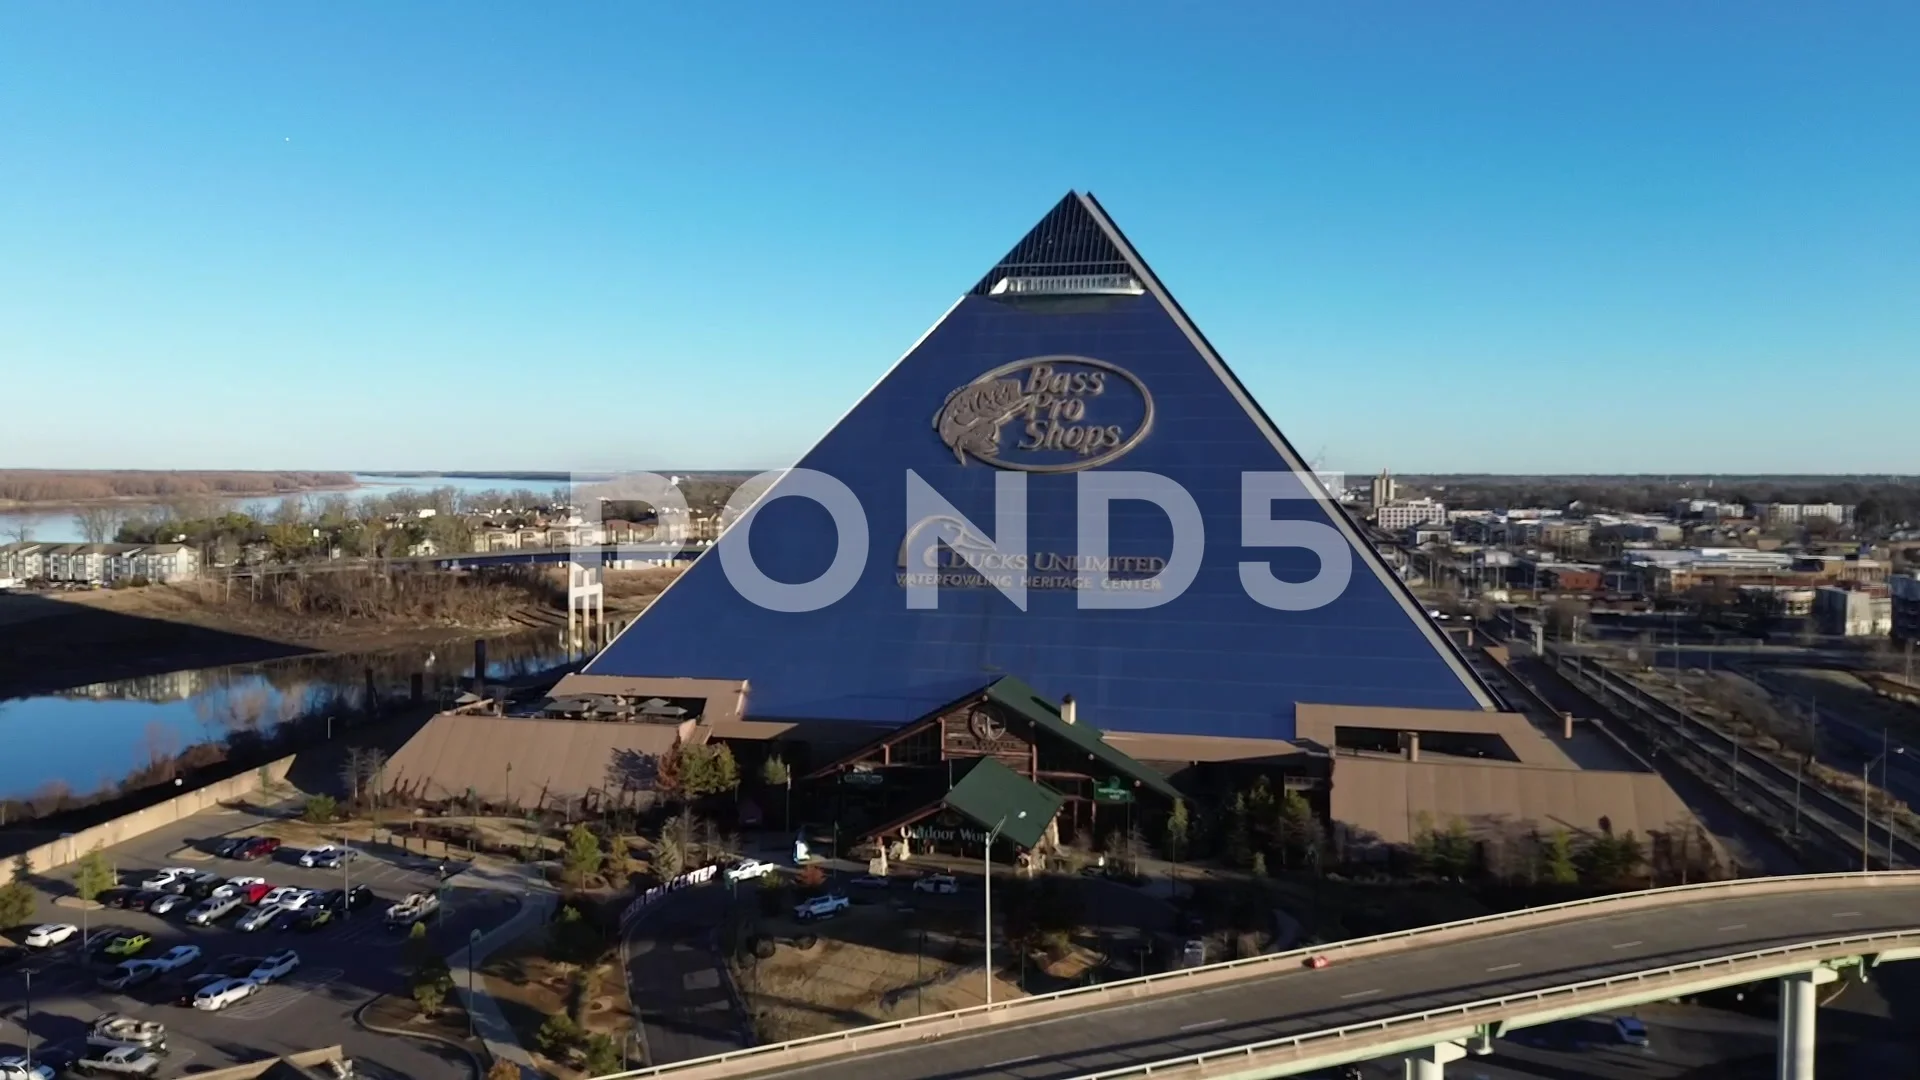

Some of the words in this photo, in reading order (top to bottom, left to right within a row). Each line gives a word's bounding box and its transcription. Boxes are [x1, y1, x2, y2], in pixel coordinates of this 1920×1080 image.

[1023, 364, 1106, 395] Bass
[1025, 394, 1085, 421] Pro
[1017, 420, 1122, 455] Shops
[951, 551, 1028, 571] DUCKS
[1034, 552, 1167, 574] UNLIMITED
[896, 572, 1013, 588] WATERFOWLING
[1020, 575, 1093, 590] HERITAGE
[1101, 577, 1163, 591] CENTER
[900, 825, 956, 841] Outdoor
[959, 828, 999, 844] Wor
